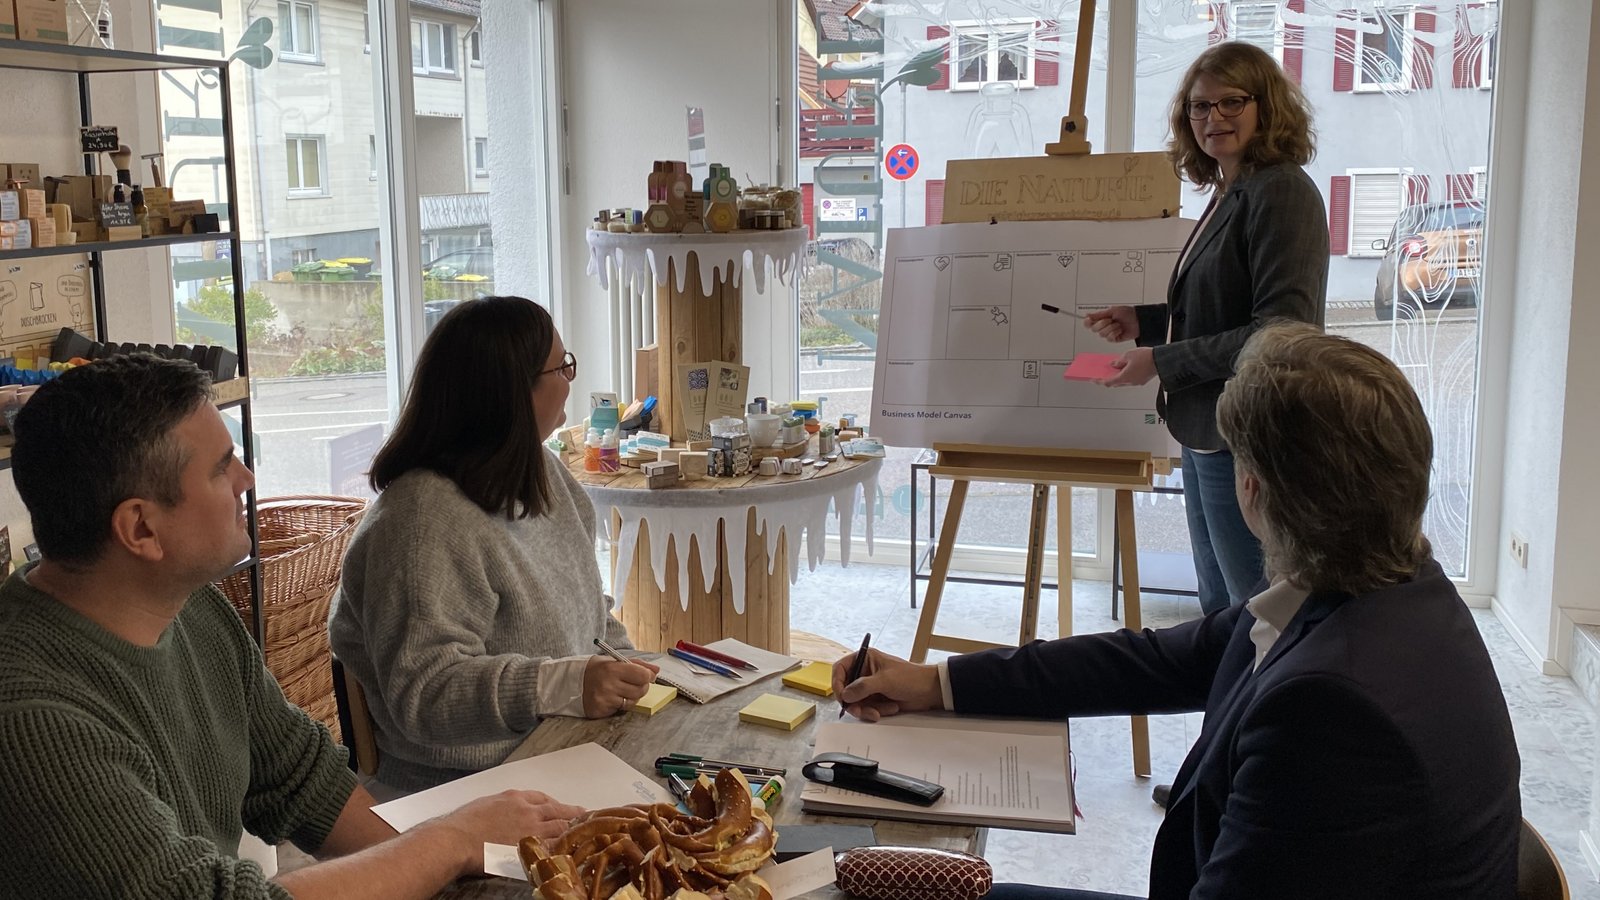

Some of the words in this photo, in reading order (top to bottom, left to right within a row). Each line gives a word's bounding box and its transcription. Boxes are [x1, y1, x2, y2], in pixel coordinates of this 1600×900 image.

[960, 180, 1008, 205] DIE
[882, 409, 914, 418] Business
[916, 411, 941, 419] Model
[943, 411, 971, 419] Canvas
